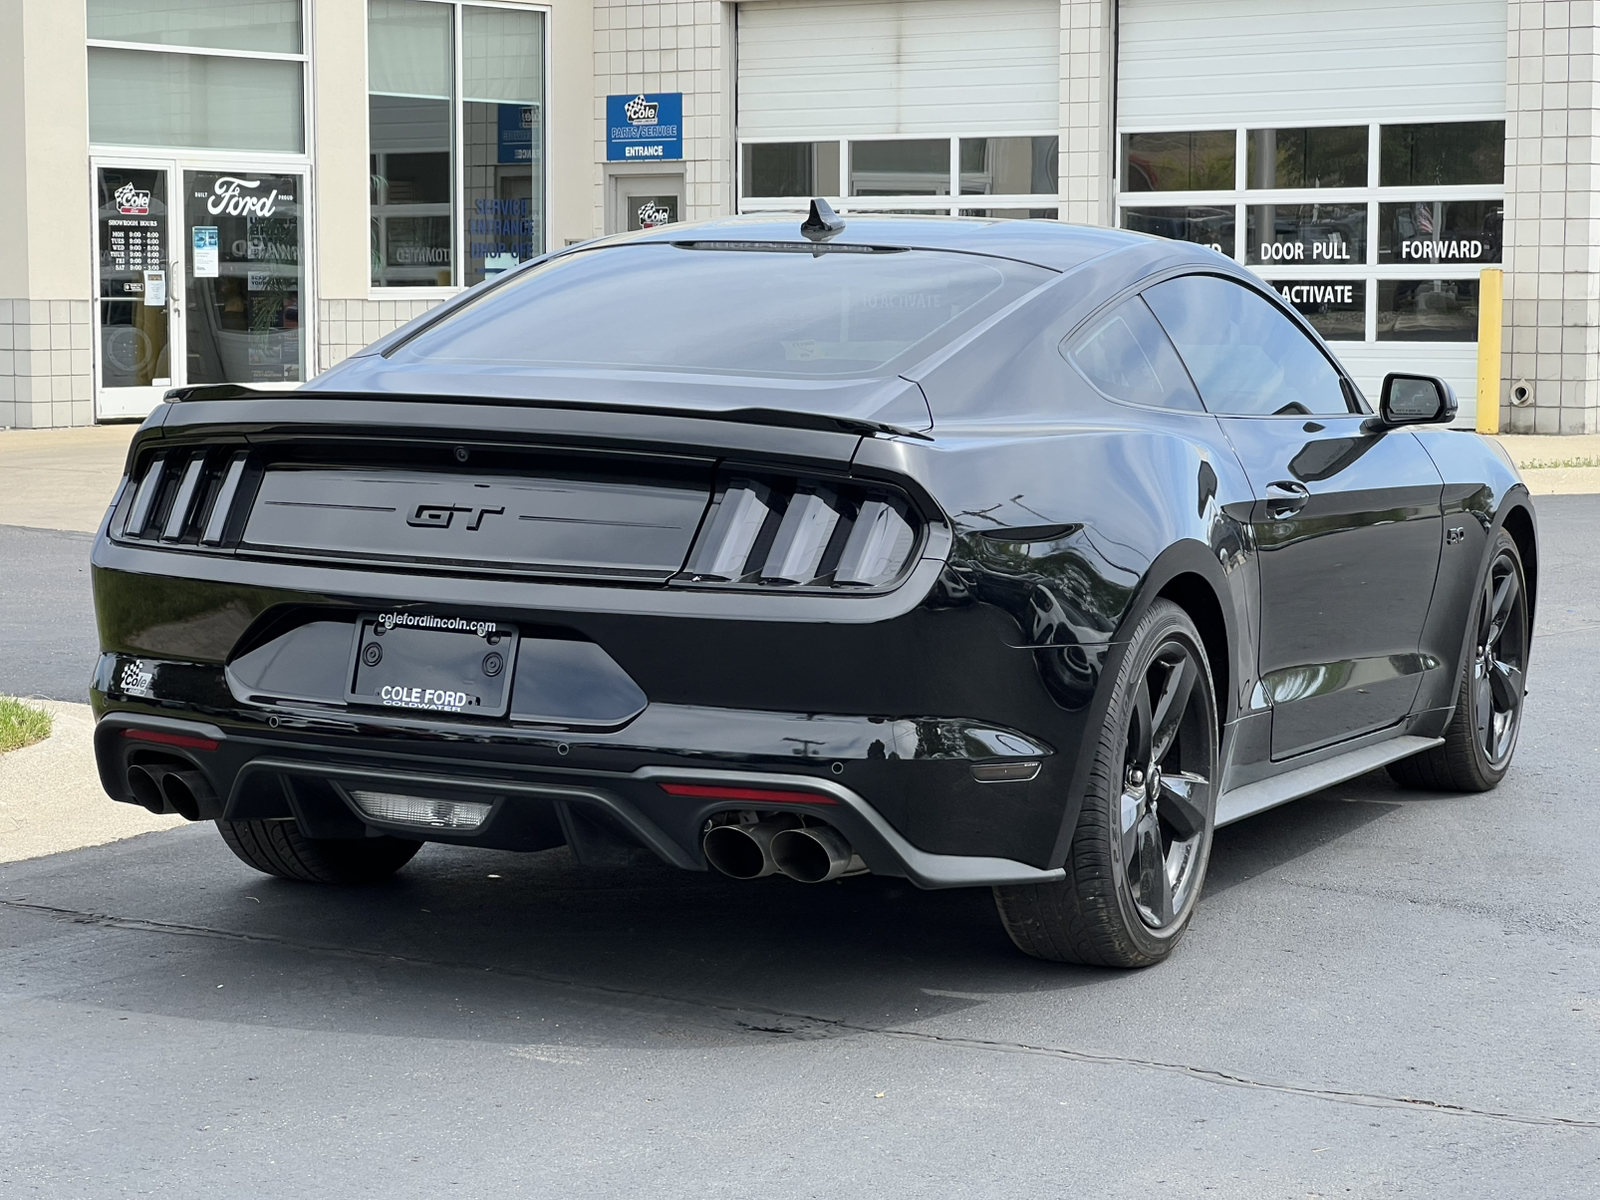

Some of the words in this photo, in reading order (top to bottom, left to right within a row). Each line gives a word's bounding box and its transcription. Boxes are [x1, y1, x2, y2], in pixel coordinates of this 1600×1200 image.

[631, 106, 655, 119] Cole
[611, 125, 677, 138] PARTS/SERVICE
[625, 145, 663, 157] ENTRANCE
[122, 192, 149, 207] Cole
[207, 176, 278, 217] Ford
[475, 199, 528, 216] SERVICE
[645, 209, 667, 222] Cole
[469, 219, 535, 236] ENTRANCE
[1261, 242, 1304, 260] DOOR
[1312, 242, 1351, 260] PULL
[1402, 240, 1482, 259] FORWARD
[1281, 286, 1353, 303] ACTIVATE
[406, 501, 505, 531] GT
[378, 612, 496, 632] colefordlincoln.com
[125, 673, 147, 688] Cole
[381, 685, 421, 703] COLE
[424, 689, 467, 707] FORD
[383, 700, 462, 712] COLDWATER
